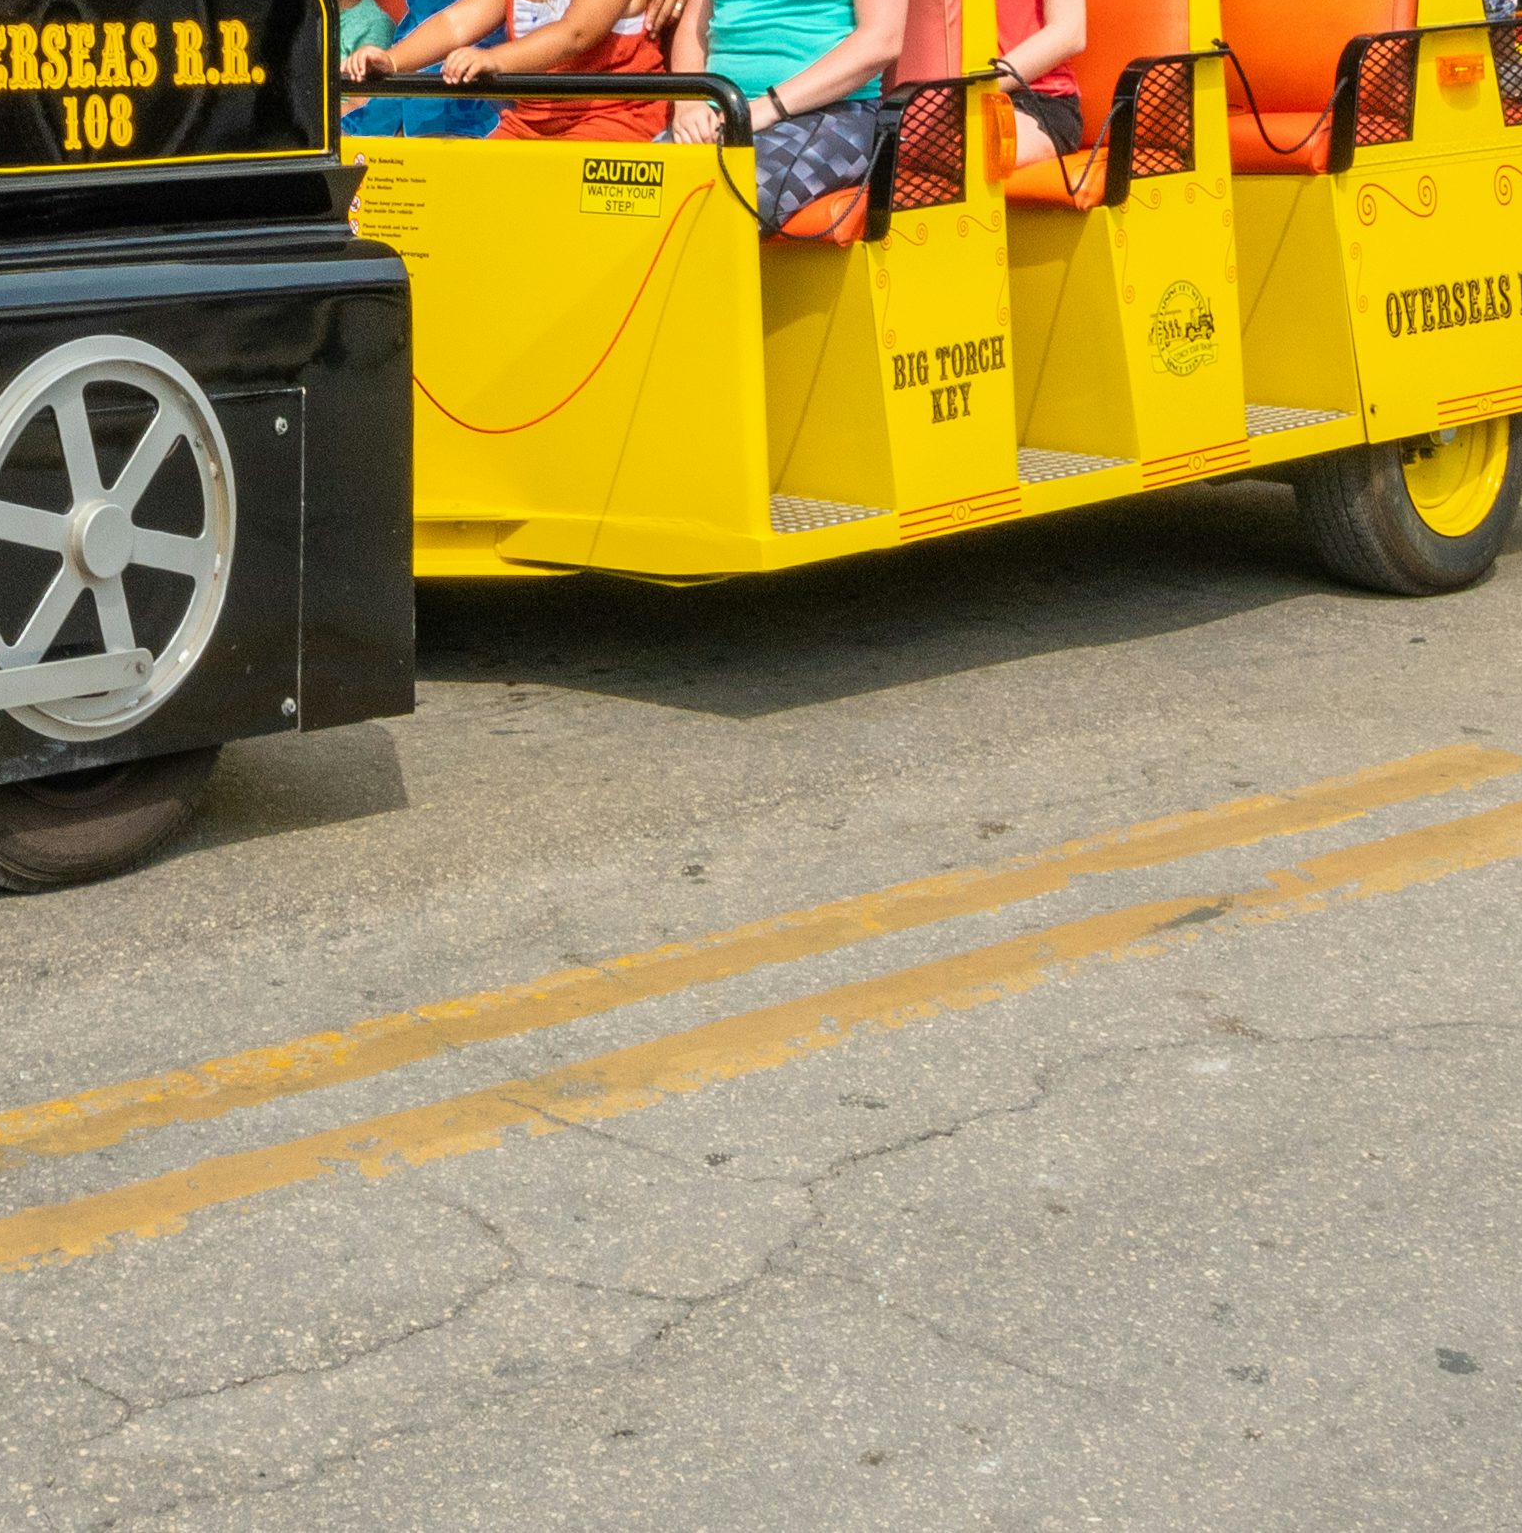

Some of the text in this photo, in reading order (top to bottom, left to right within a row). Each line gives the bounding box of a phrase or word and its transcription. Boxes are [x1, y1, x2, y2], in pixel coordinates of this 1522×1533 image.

[171, 19, 267, 87] R.R.
[62, 92, 134, 151] 108
[378, 157, 404, 165] Smoking
[585, 160, 662, 183] CAUTION
[587, 184, 656, 200] WATCH YOUR
[605, 199, 635, 213] STEP!
[1385, 274, 1513, 339] OVERSEAS
[891, 334, 1006, 391] BIG TORCH
[930, 381, 972, 424] KEY
